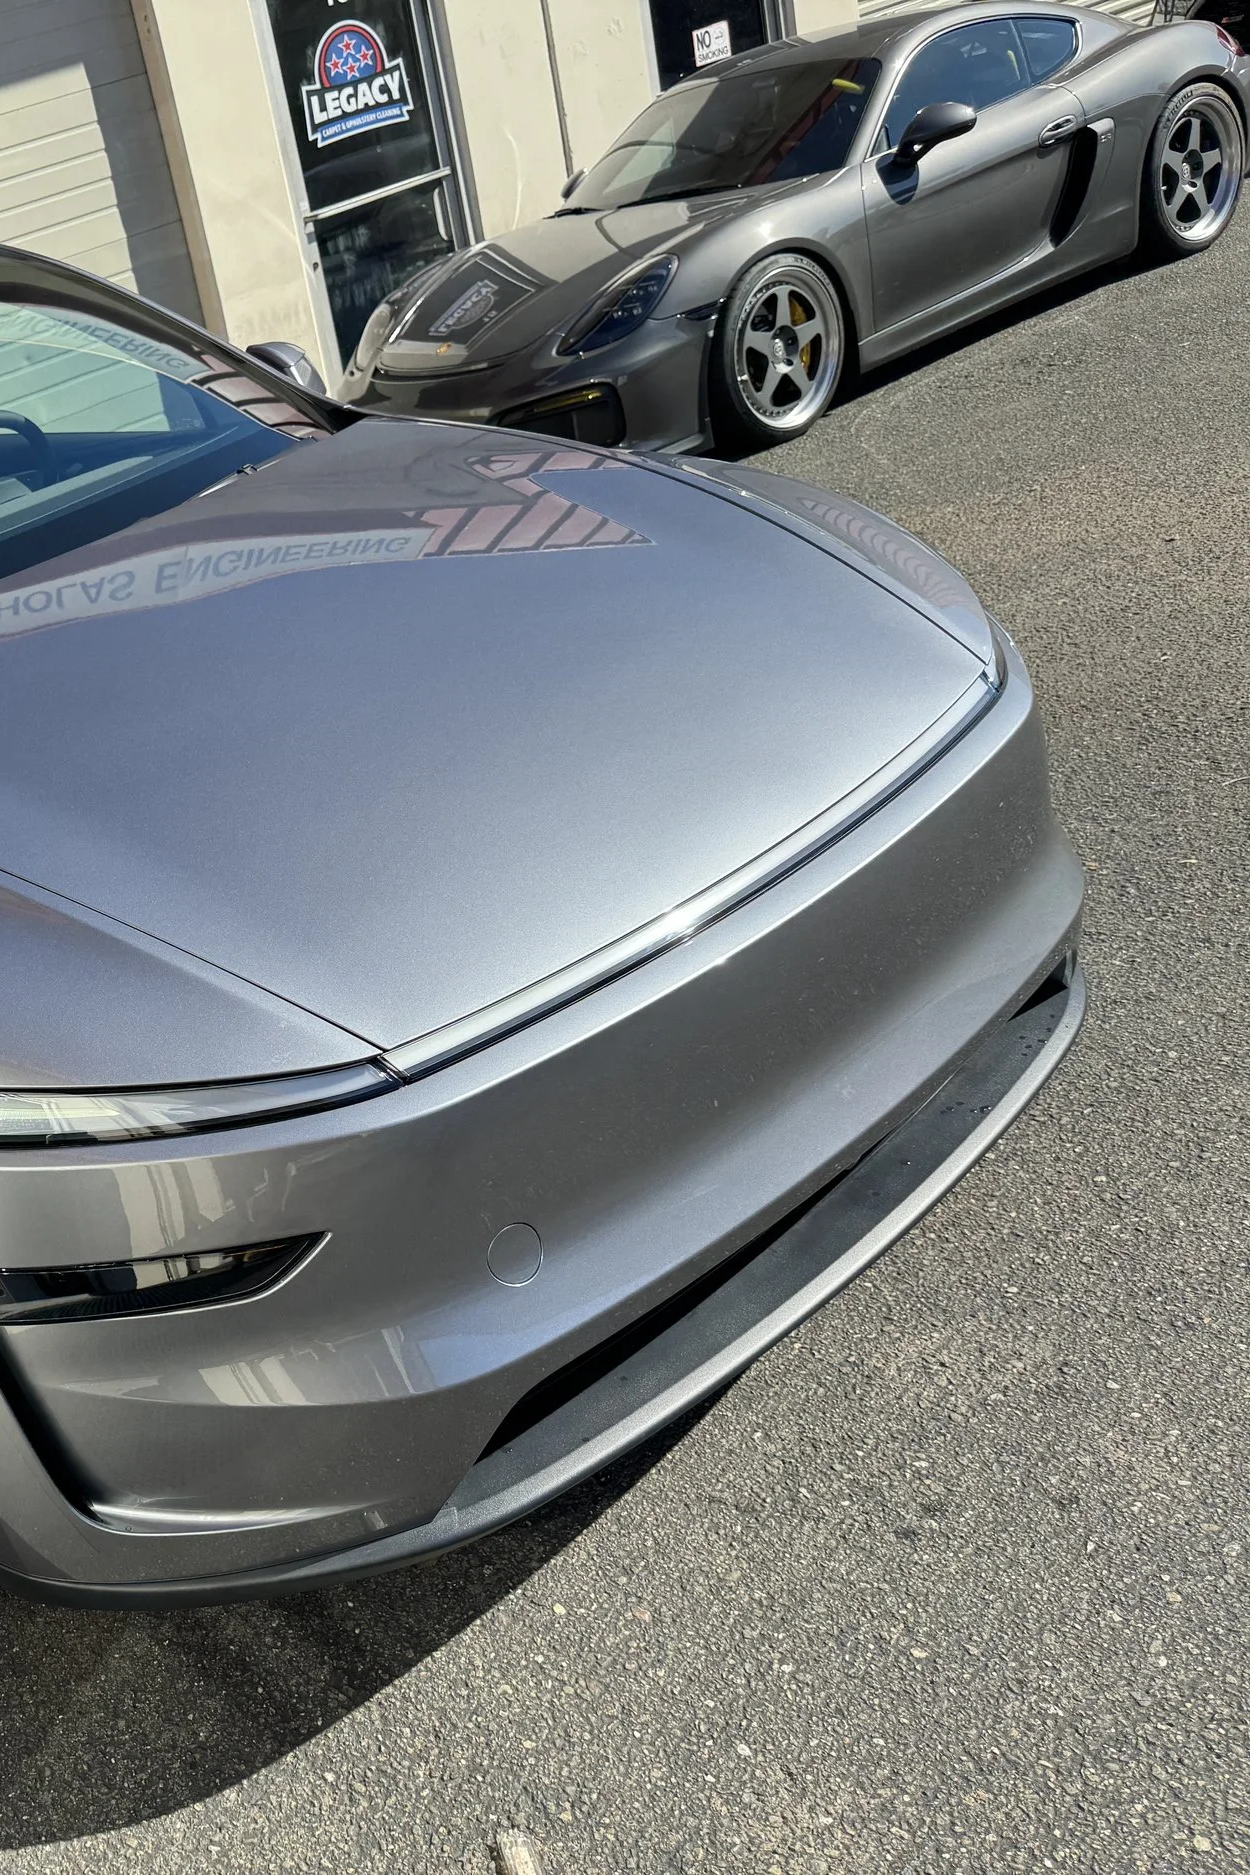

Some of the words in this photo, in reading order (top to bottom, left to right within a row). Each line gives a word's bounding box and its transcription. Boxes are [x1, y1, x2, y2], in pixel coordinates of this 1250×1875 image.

[696, 30, 712, 51] NO
[698, 45, 729, 63] SMOKING
[310, 70, 401, 124] LEGACY
[322, 124, 341, 138] CARPET
[376, 107, 402, 119] CLEANING
